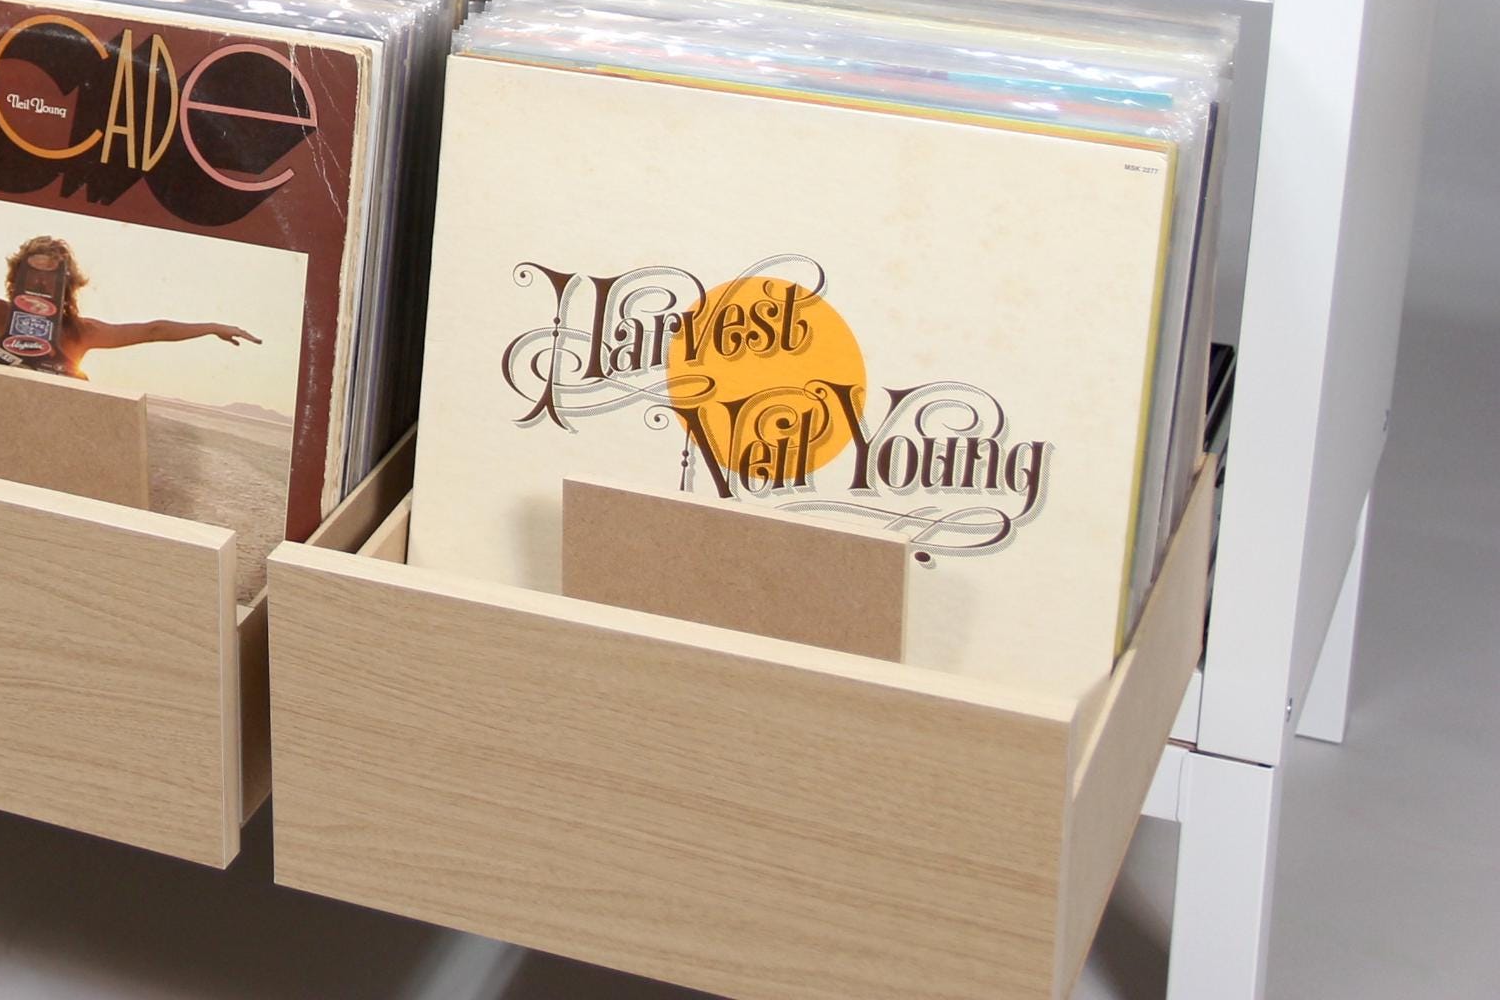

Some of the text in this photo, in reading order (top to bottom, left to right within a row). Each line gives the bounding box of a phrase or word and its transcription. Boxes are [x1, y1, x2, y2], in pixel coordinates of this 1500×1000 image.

[6, 93, 67, 119] Neil Young
[501, 252, 830, 435] Harvest
[644, 378, 1056, 552] Neil Young
